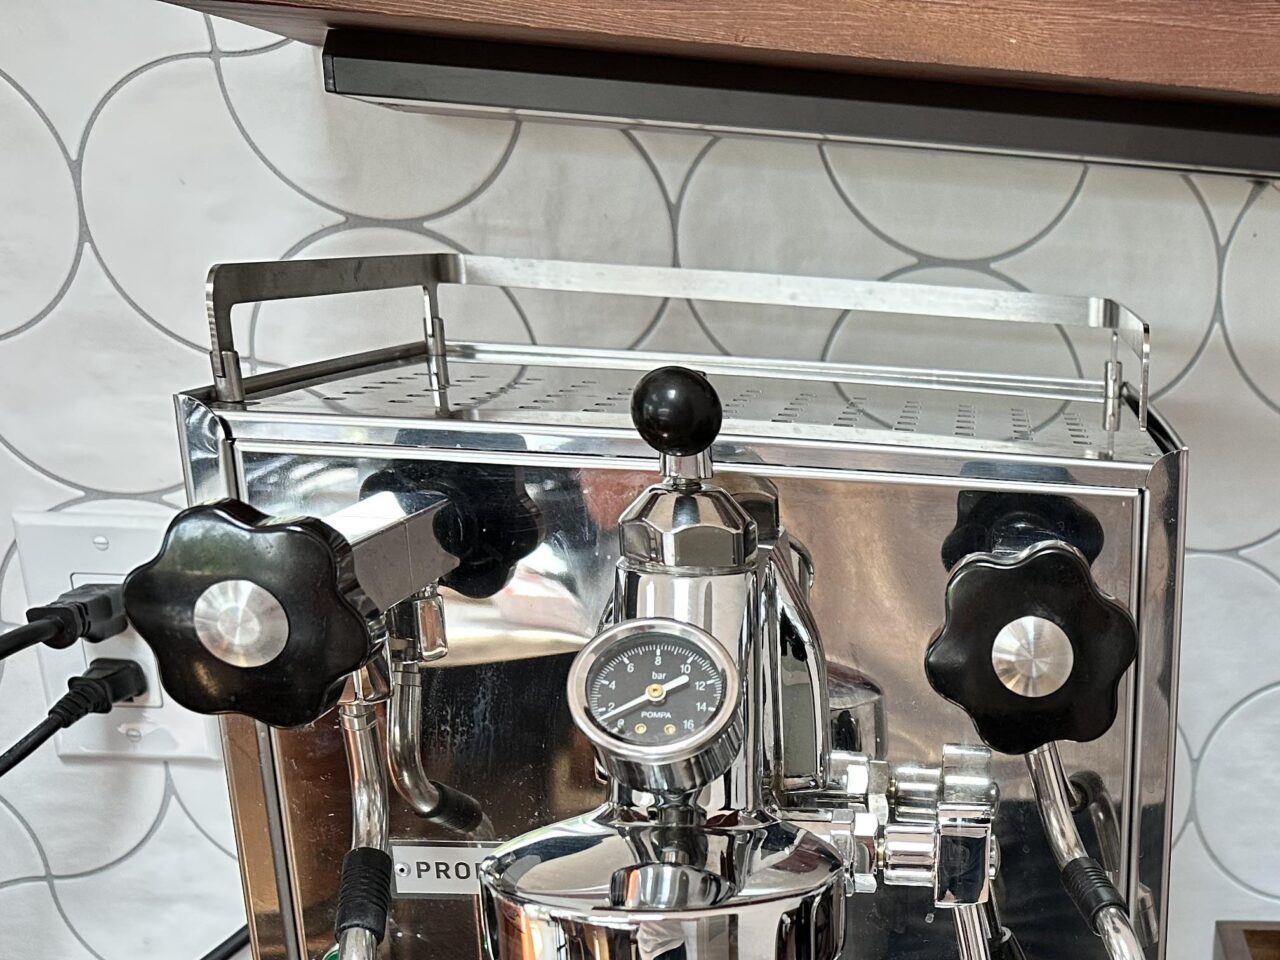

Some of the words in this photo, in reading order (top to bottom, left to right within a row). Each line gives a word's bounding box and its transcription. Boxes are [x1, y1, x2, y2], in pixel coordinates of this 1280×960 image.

[654, 656, 662, 665] 8
[627, 663, 634, 673] 6
[680, 664, 691, 674] 10
[651, 671, 666, 680] bar
[608, 680, 616, 690] 4
[695, 681, 706, 691] 12
[607, 702, 615, 711] 2
[696, 702, 707, 712] 14
[641, 711, 672, 719] POMPA
[683, 719, 695, 730] 16
